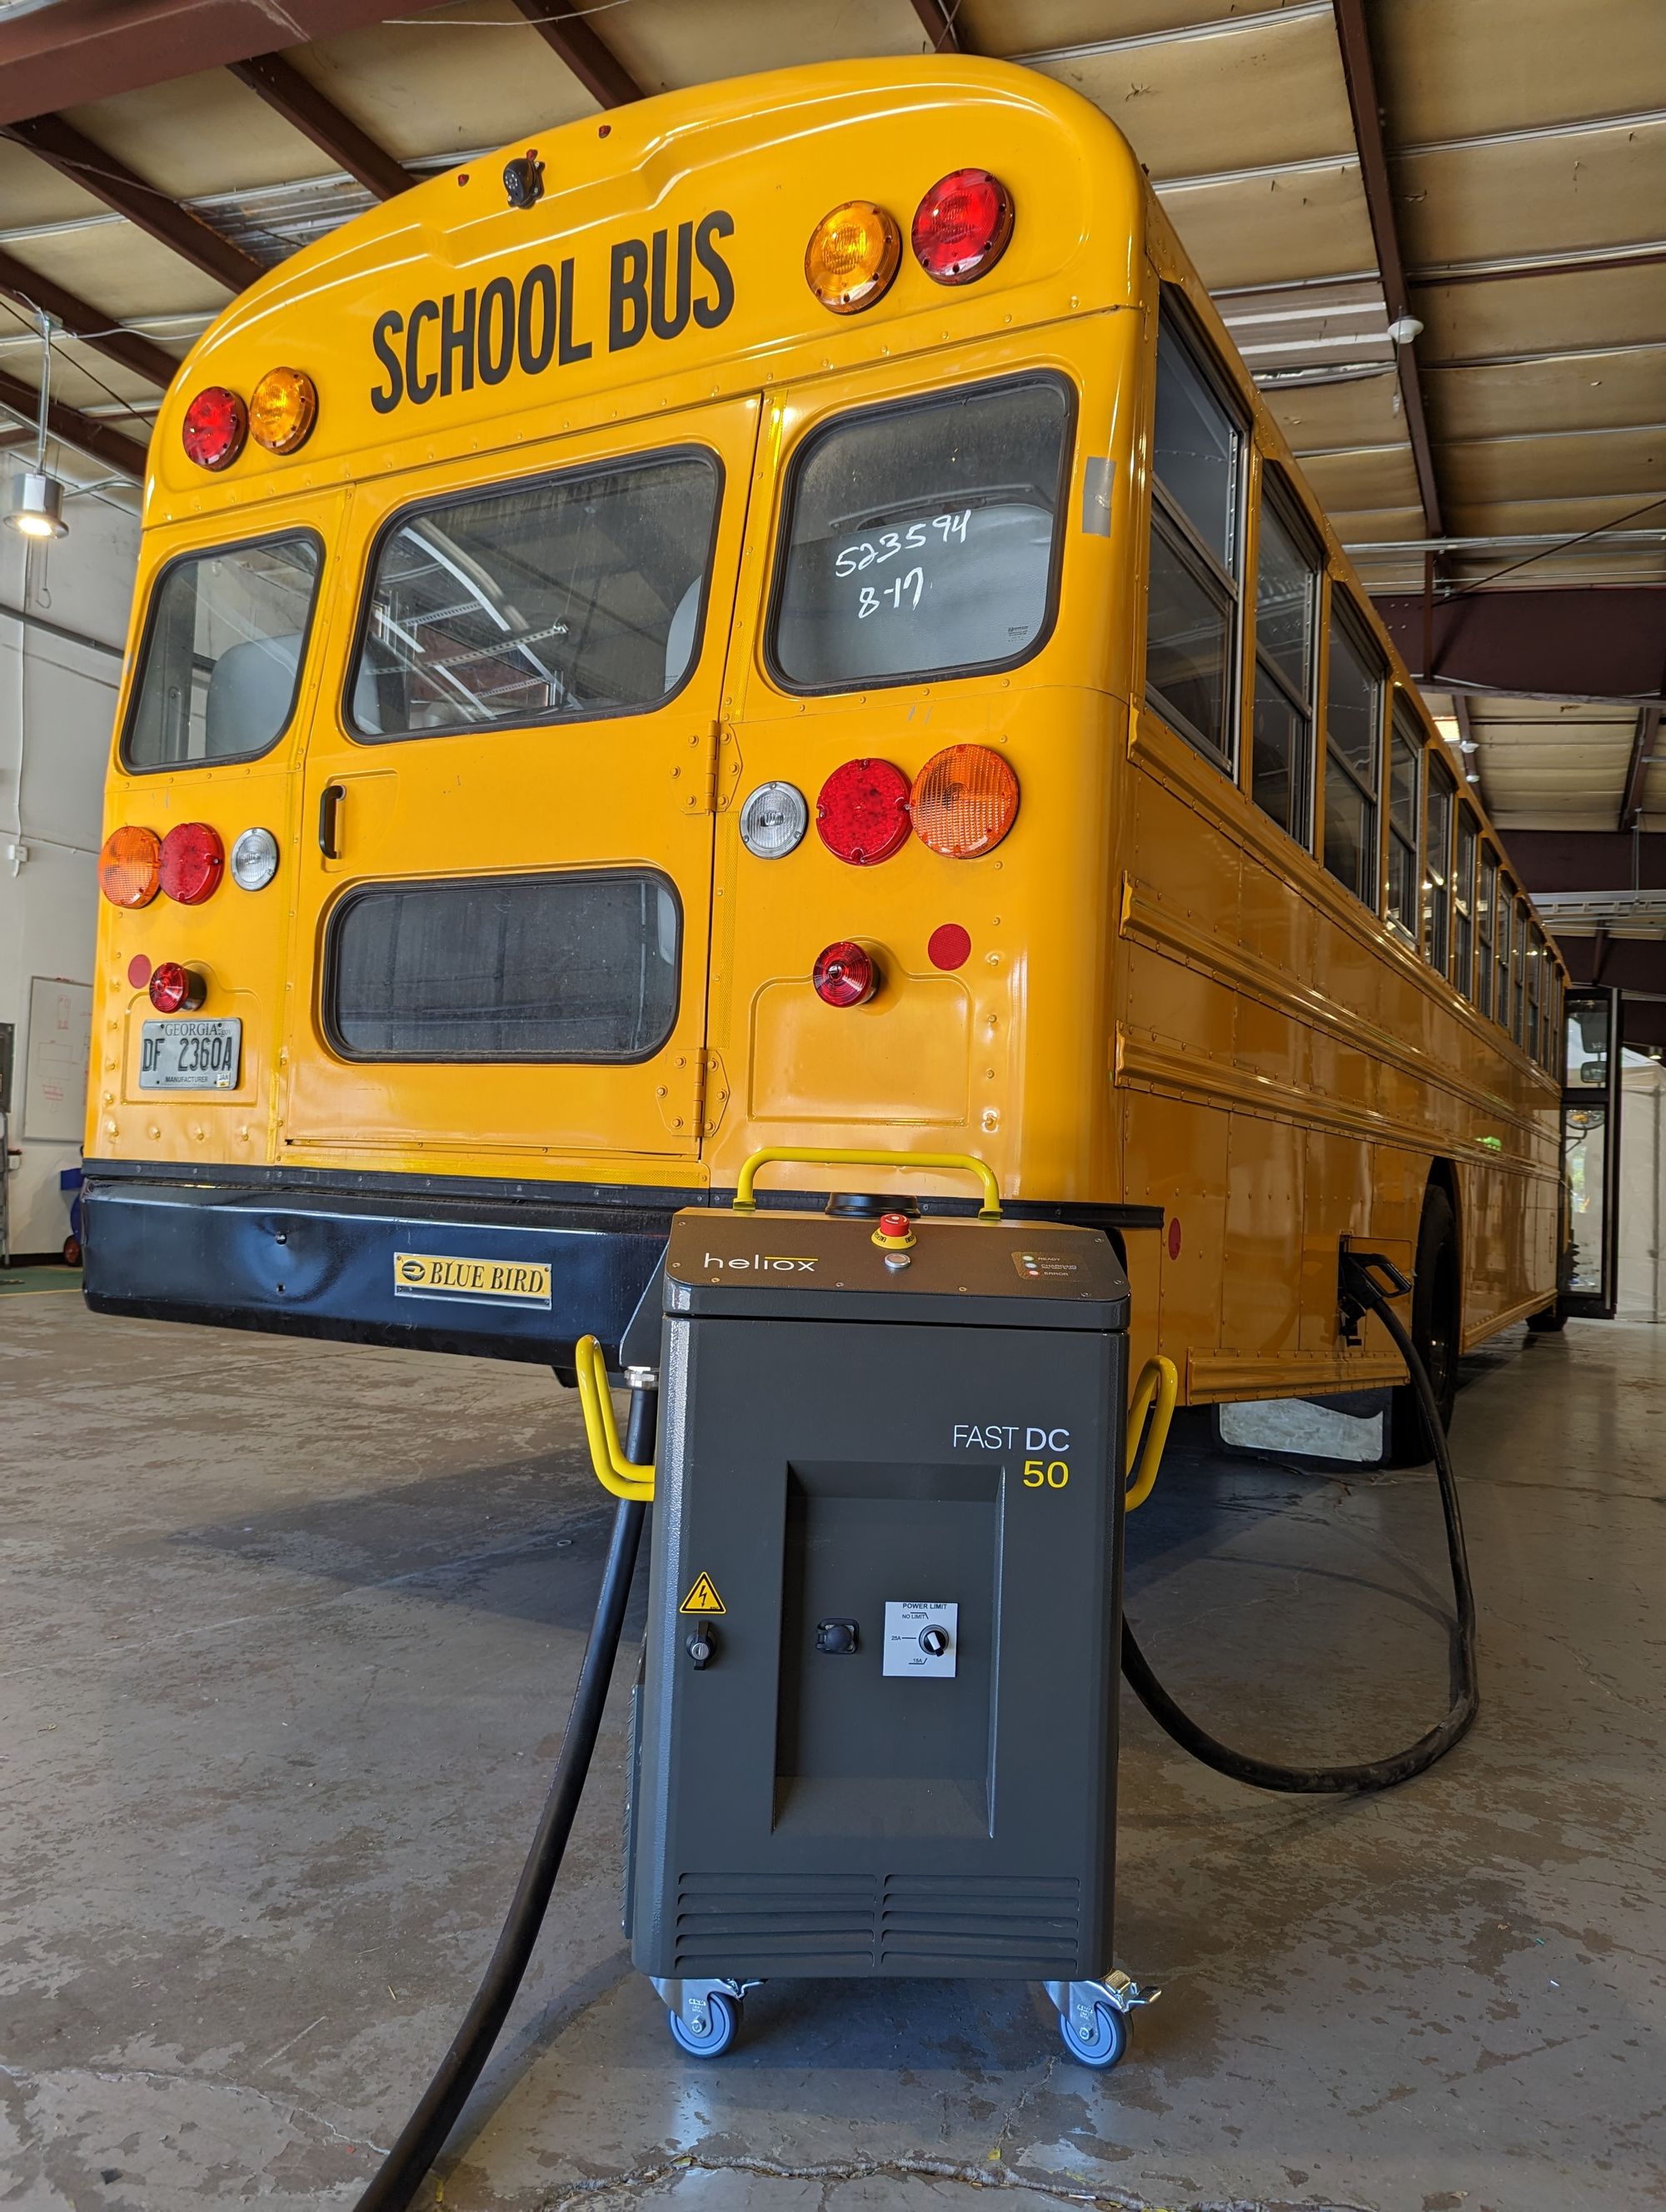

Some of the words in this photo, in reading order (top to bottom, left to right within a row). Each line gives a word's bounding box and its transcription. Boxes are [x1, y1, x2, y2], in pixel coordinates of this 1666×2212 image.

[370, 257, 592, 415] SCHOOL
[608, 210, 735, 353] BUS
[835, 510, 972, 577] 523594
[142, 1038, 165, 1072] DF
[177, 1037, 232, 1072] 2360A
[430, 1260, 485, 1288] BLUE
[490, 1266, 543, 1293] BIRD
[704, 1253, 816, 1272] heliox
[953, 1425, 1020, 1450] FAST
[1025, 1427, 1070, 1452] DC
[1023, 1460, 1070, 1488] 50
